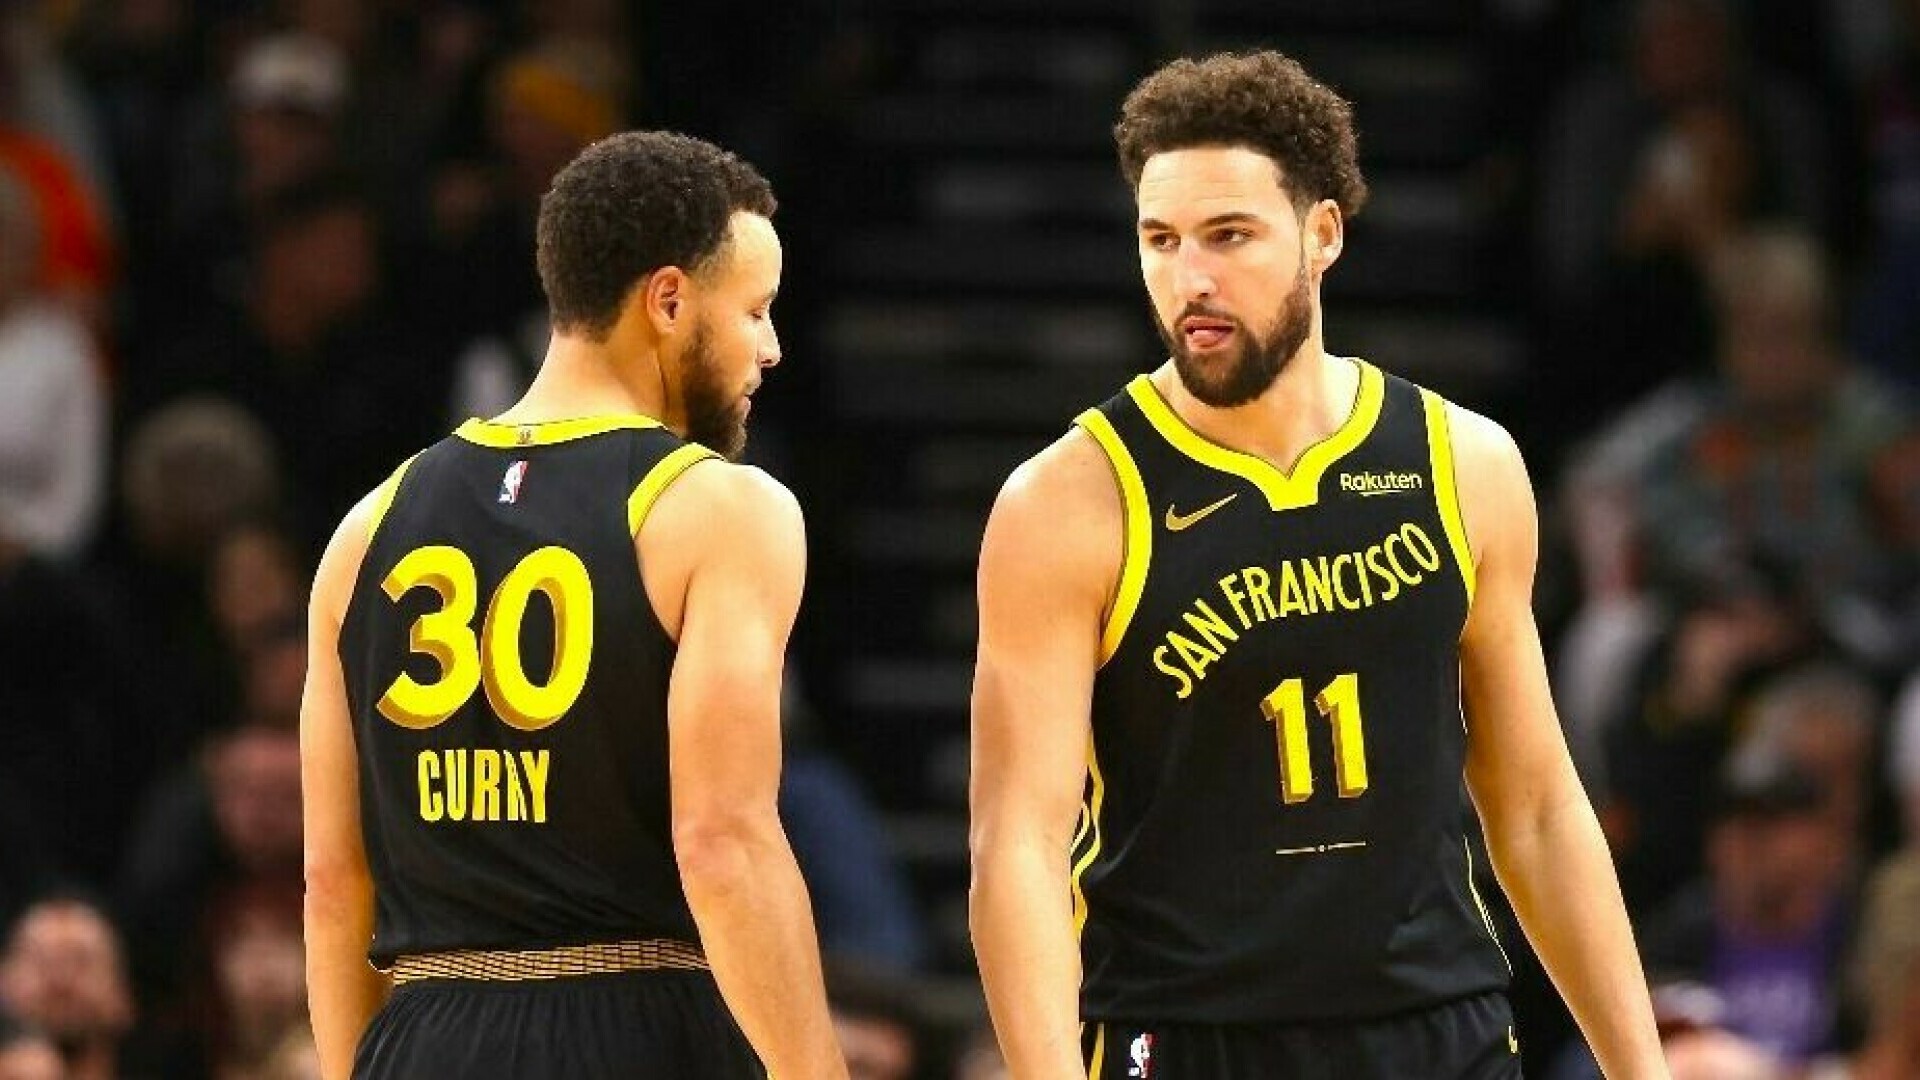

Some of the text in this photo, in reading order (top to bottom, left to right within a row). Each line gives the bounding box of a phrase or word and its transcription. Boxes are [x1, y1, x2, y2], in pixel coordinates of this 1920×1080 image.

[1340, 471, 1423, 491] Rakuten
[377, 546, 594, 730] 30
[1153, 522, 1440, 699] SAN FRANCISCO
[1259, 672, 1368, 804] 11
